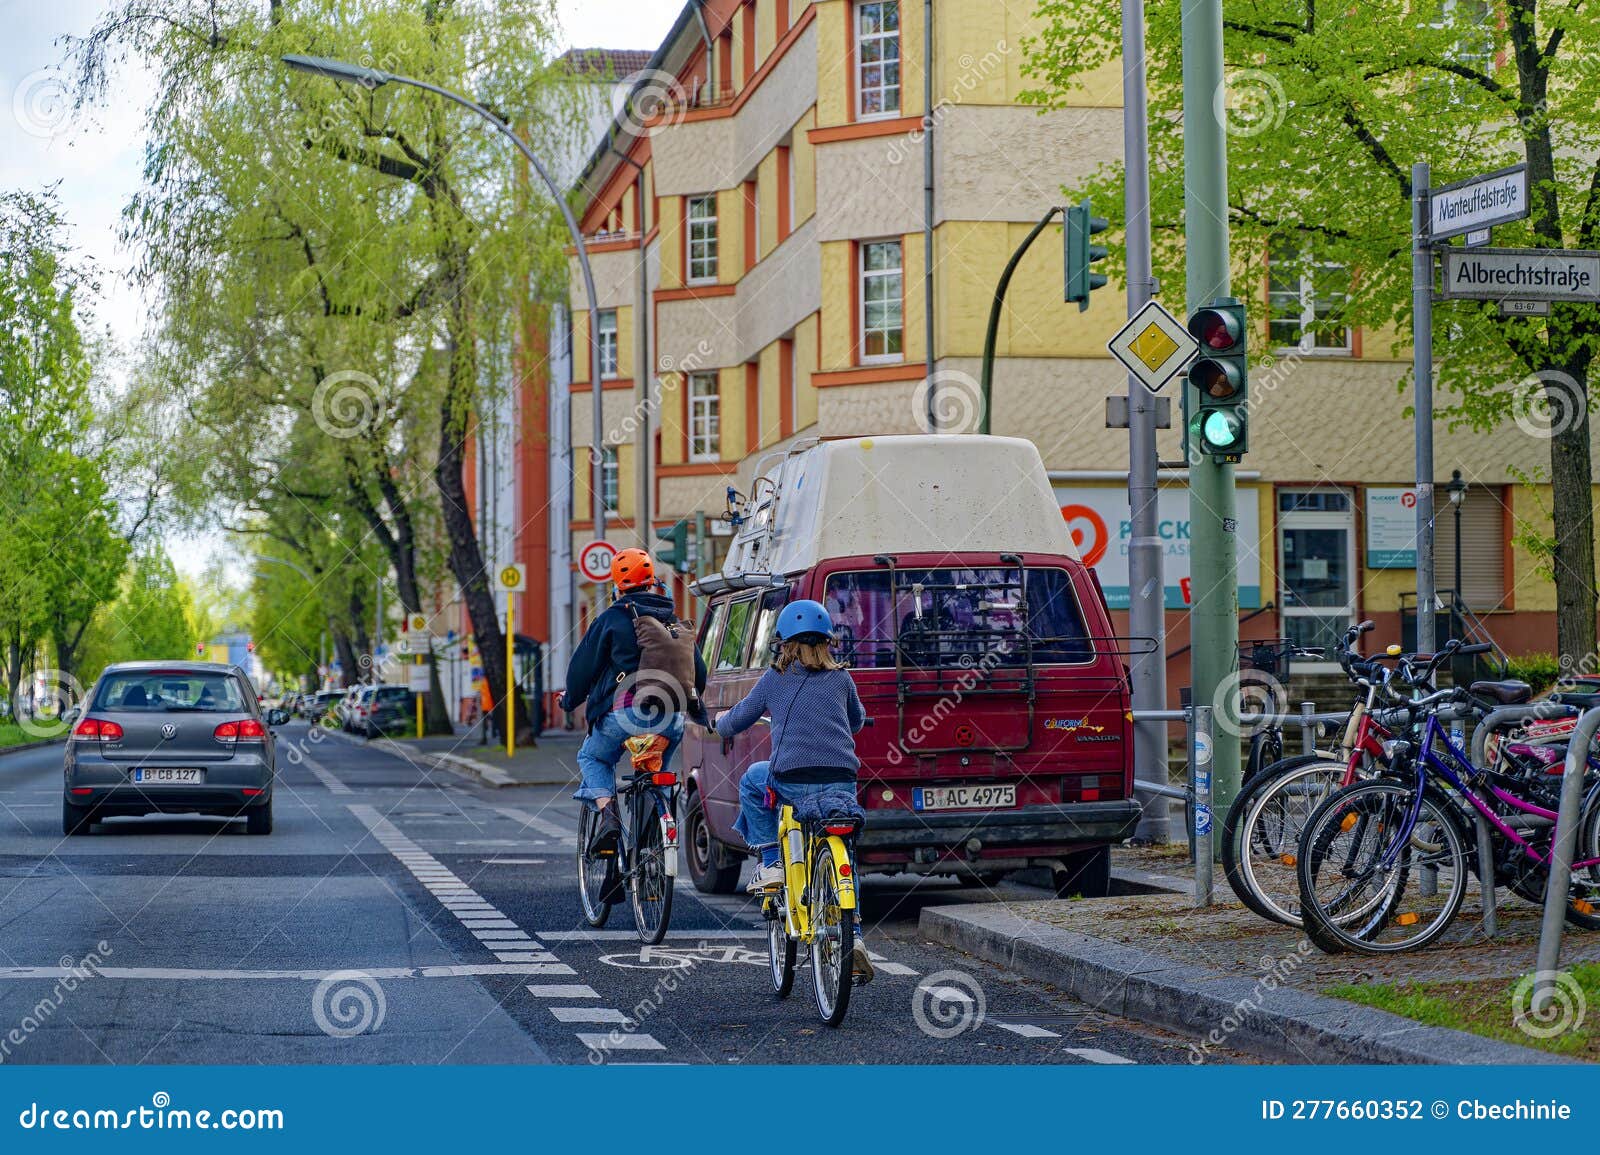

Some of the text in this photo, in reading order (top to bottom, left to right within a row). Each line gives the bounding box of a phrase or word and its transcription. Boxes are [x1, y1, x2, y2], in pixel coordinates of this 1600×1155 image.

[1439, 179, 1517, 221] Manteuffelstraße
[1457, 262, 1590, 291] Albrechtstraße
[589, 552, 611, 570] 30
[144, 768, 197, 780] B CB 127
[924, 786, 1015, 807] B AC 4975
